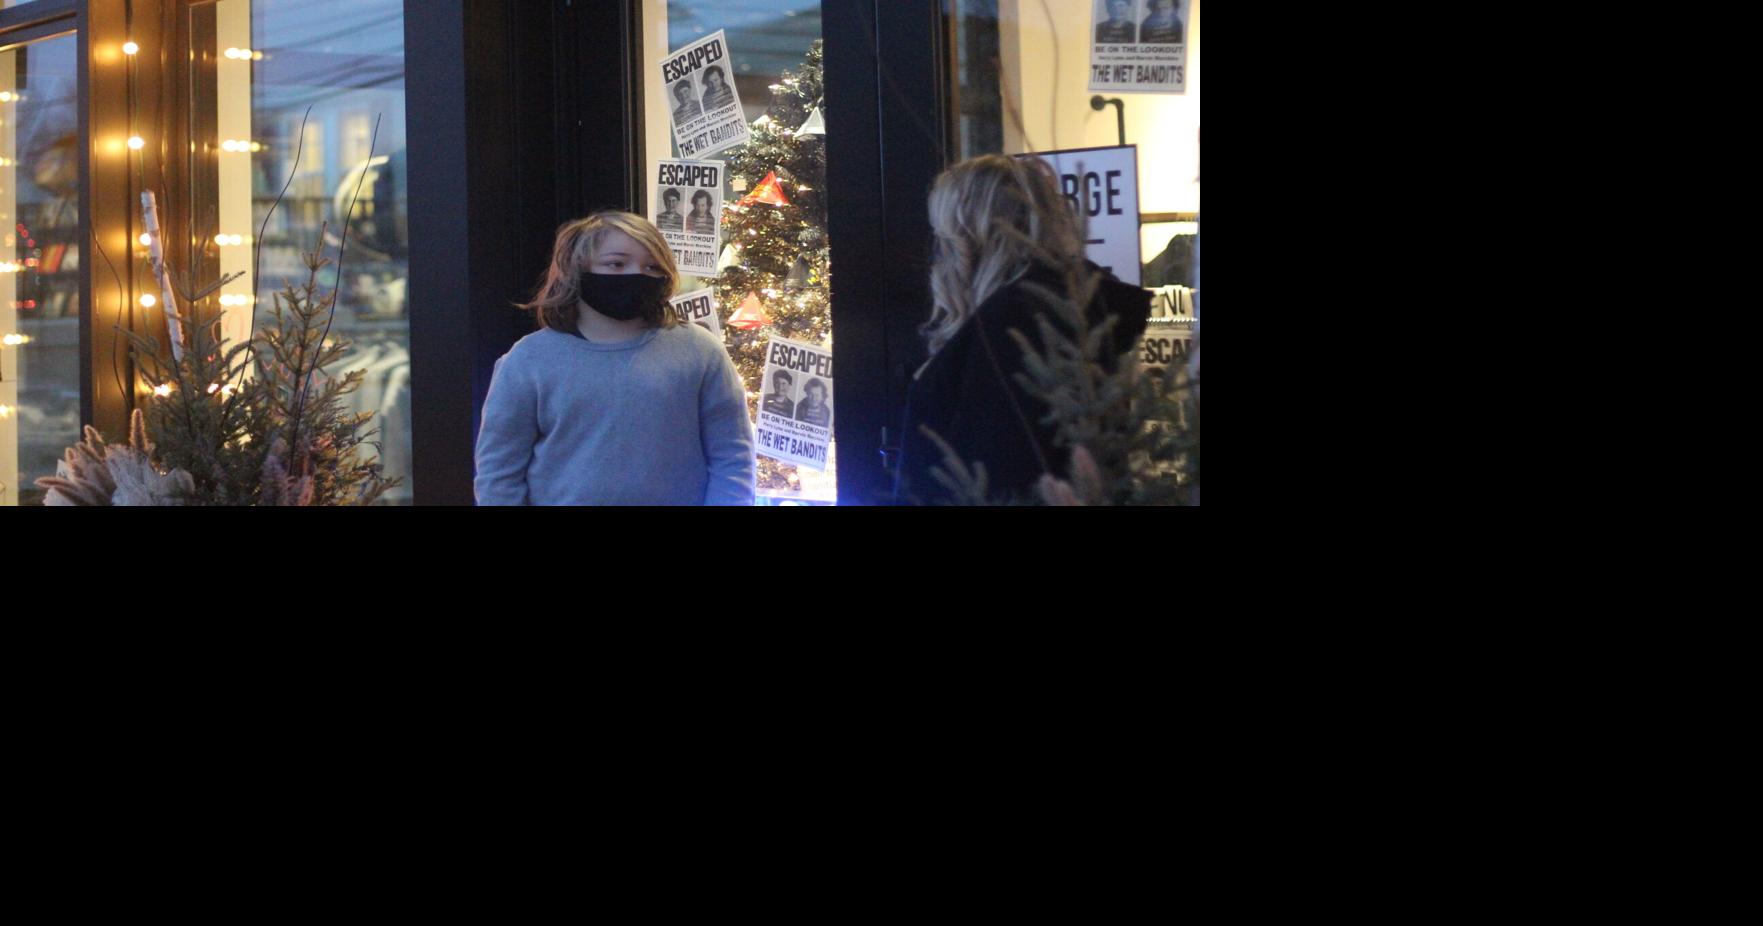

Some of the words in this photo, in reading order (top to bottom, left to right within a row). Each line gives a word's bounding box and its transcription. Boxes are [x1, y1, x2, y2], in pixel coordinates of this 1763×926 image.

[662, 39, 722, 84] ESCAPED
[1140, 46, 1184, 54] LOOKOUT
[1092, 64, 1110, 83] THE
[1113, 64, 1134, 83] WET
[1136, 64, 1184, 84] BANDITS
[694, 116, 706, 126] THE
[707, 103, 737, 121] LOOKOUT
[679, 140, 694, 159] THE
[693, 132, 709, 153] WET
[709, 118, 745, 145] BANDITS
[658, 164, 718, 188] ESCAPED
[687, 235, 715, 243] LOOKOUT
[769, 342, 832, 378] ESCAPED
[771, 416, 780, 424] ON
[782, 419, 795, 429] THE
[795, 423, 829, 436] LOOKOUT
[757, 428, 772, 448] THE
[773, 433, 791, 453] WET
[790, 438, 827, 462] BANDITS
